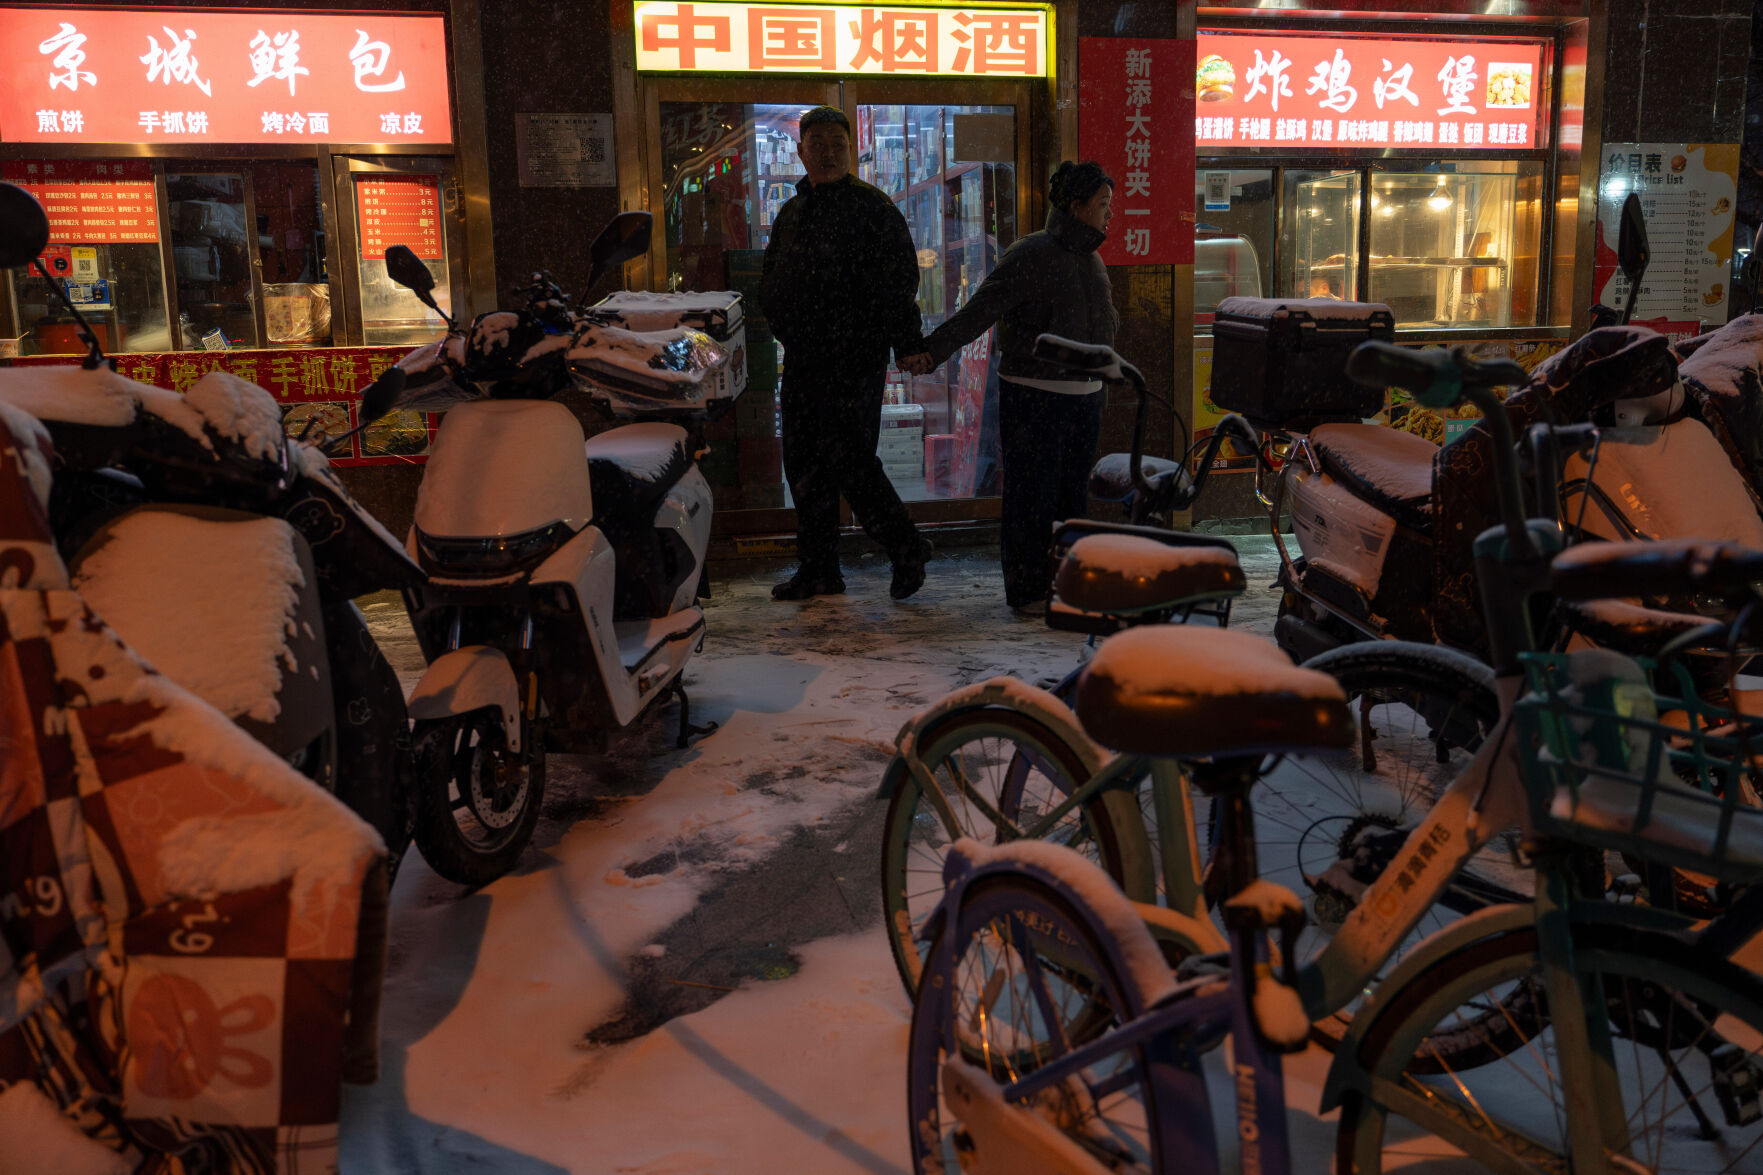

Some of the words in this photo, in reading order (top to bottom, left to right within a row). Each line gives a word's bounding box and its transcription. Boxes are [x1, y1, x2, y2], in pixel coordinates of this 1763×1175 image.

[39, 22, 406, 97] 京城鲜包
[642, 3, 1040, 74] 中国烟酒
[1244, 48, 1479, 116] 炸鸡汉堡
[36, 109, 84, 134] 煎饼
[138, 109, 209, 135] 手抓饼
[261, 111, 330, 135] 烤冷面
[380, 113, 424, 135] 凉皮
[1312, 119, 1332, 141] 汉堡
[1124, 48, 1152, 256] 新添大饼夹一切
[1608, 153, 1662, 173] 价目表
[271, 355, 358, 396] 手抓饼
